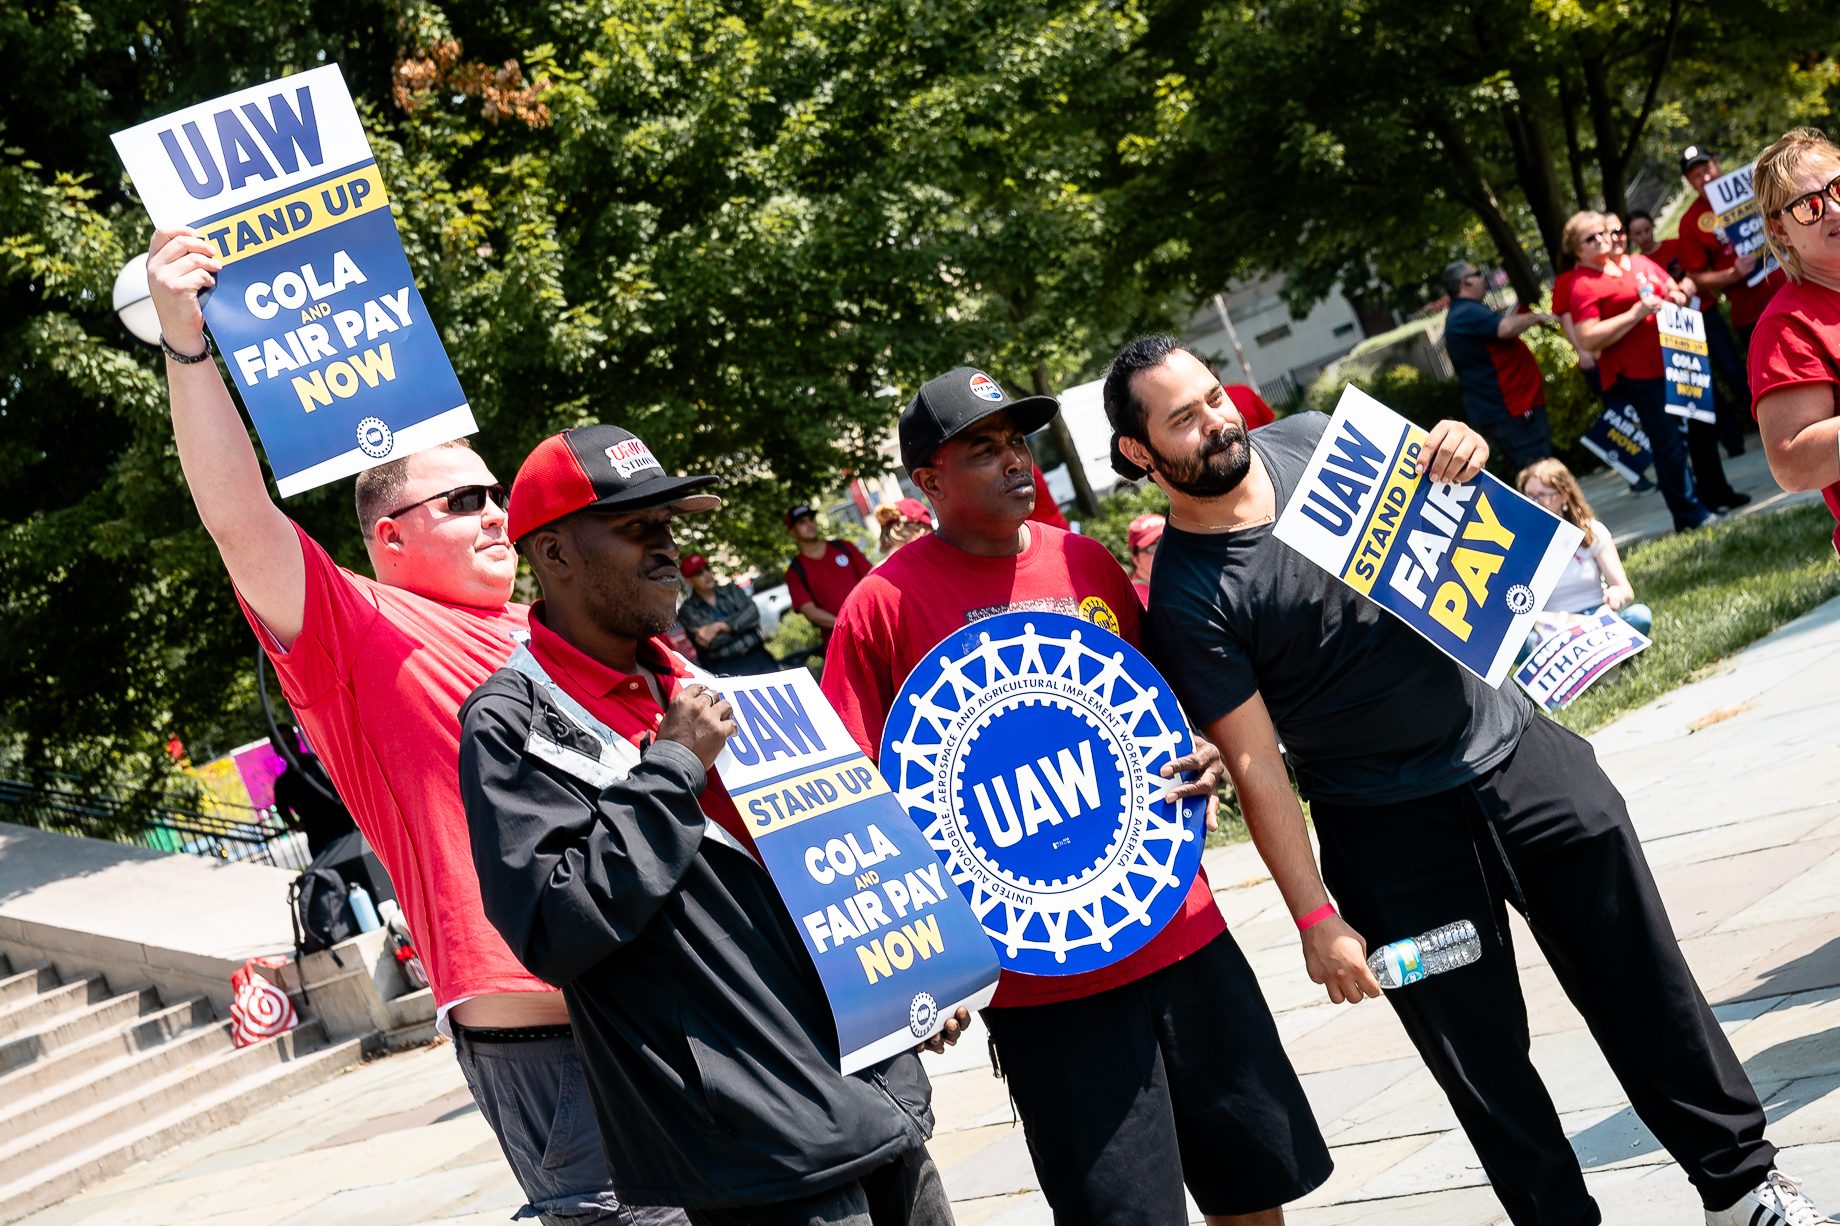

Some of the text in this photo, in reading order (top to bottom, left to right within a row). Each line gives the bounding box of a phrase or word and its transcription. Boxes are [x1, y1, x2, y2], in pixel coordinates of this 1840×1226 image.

[158, 86, 324, 200] UAW
[197, 178, 371, 259] TAND UP
[244, 249, 368, 320] COLA
[301, 303, 332, 325] AND
[1665, 308, 1694, 333] UAW
[233, 286, 414, 387] FAIR PAY
[291, 342, 396, 414] NOW
[1300, 419, 1387, 537] UAW
[1355, 442, 1422, 580] STAND UP
[1388, 480, 1476, 609] FAIR
[1428, 491, 1516, 643] PAY
[1538, 631, 1616, 691] ITHACA
[747, 766, 873, 827] STAND UP
[938, 679, 1145, 906] UNITED AUTOMOBILE, AEROSPACE AND AGRICULTURAL IMPLEMENT WORKERS OF AMERICA
[973, 739, 1101, 848] UAW
[804, 824, 902, 886] COLA
[855, 870, 880, 891] AND
[802, 862, 949, 954] FAIR PAY
[855, 914, 945, 985] NOW
